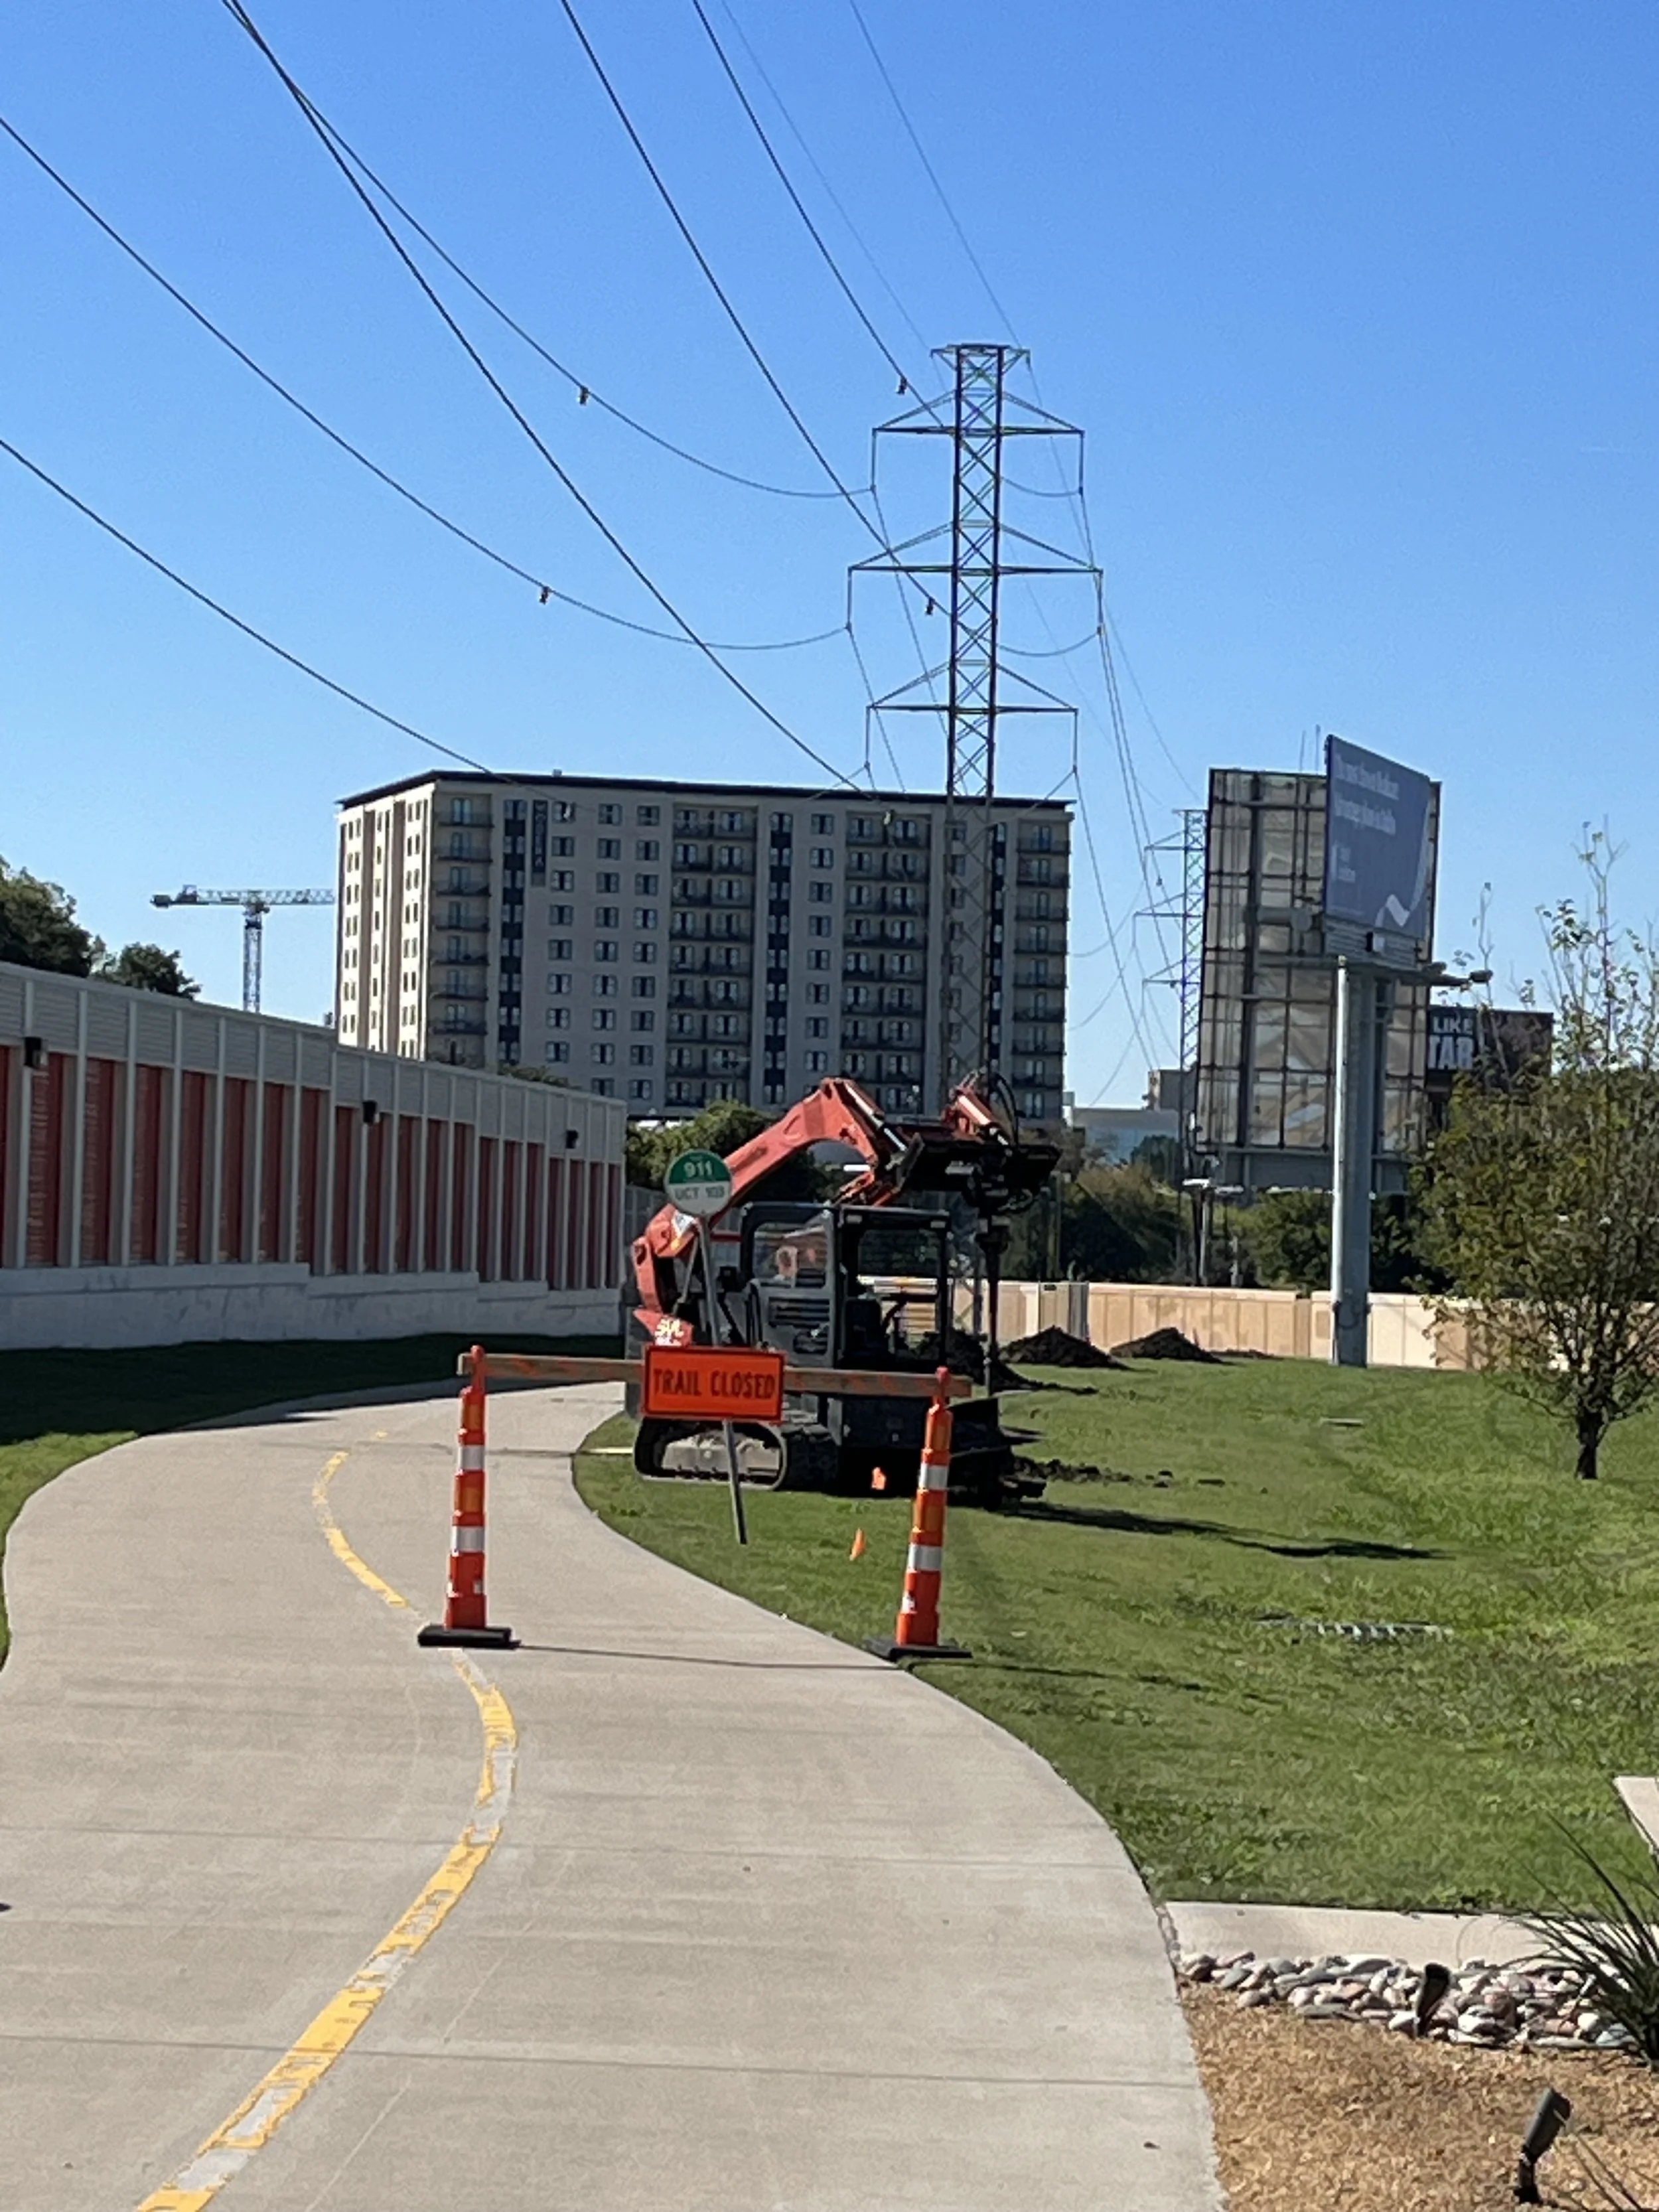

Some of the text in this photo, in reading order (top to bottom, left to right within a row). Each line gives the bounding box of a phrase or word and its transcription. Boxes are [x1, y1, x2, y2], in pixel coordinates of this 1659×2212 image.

[1433, 1016, 1473, 1035] LIKE
[684, 1160, 713, 1177] 911
[654, 1368, 775, 1399] TRAIL CLOSED
